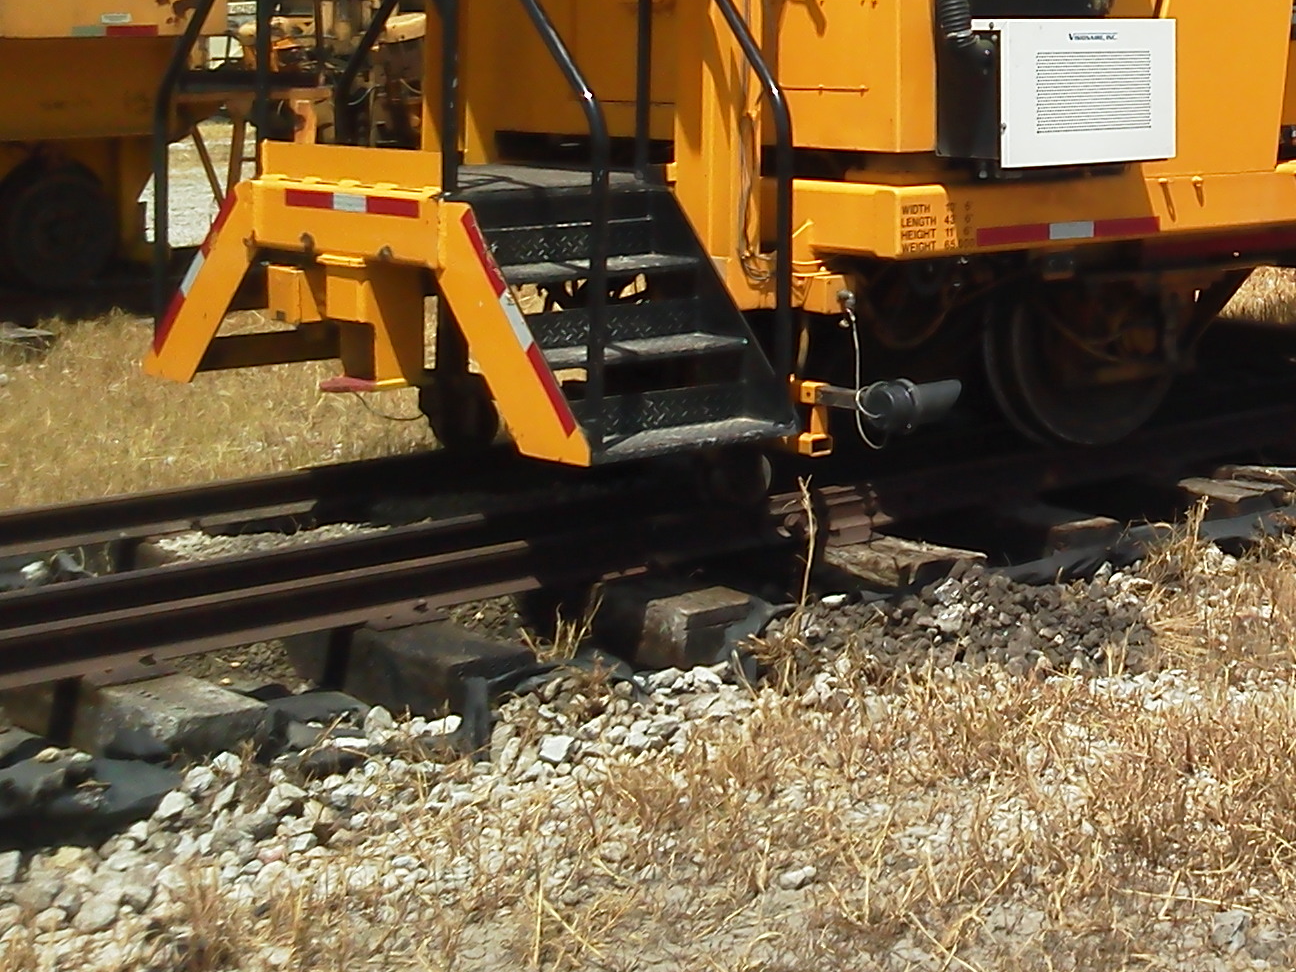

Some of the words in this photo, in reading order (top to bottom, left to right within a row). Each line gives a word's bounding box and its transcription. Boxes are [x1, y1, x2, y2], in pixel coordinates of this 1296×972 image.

[902, 204, 931, 215] WIDTH
[900, 215, 937, 228] LENGTH
[901, 228, 936, 241] HEIGHT
[902, 240, 936, 253] WEIGHT
